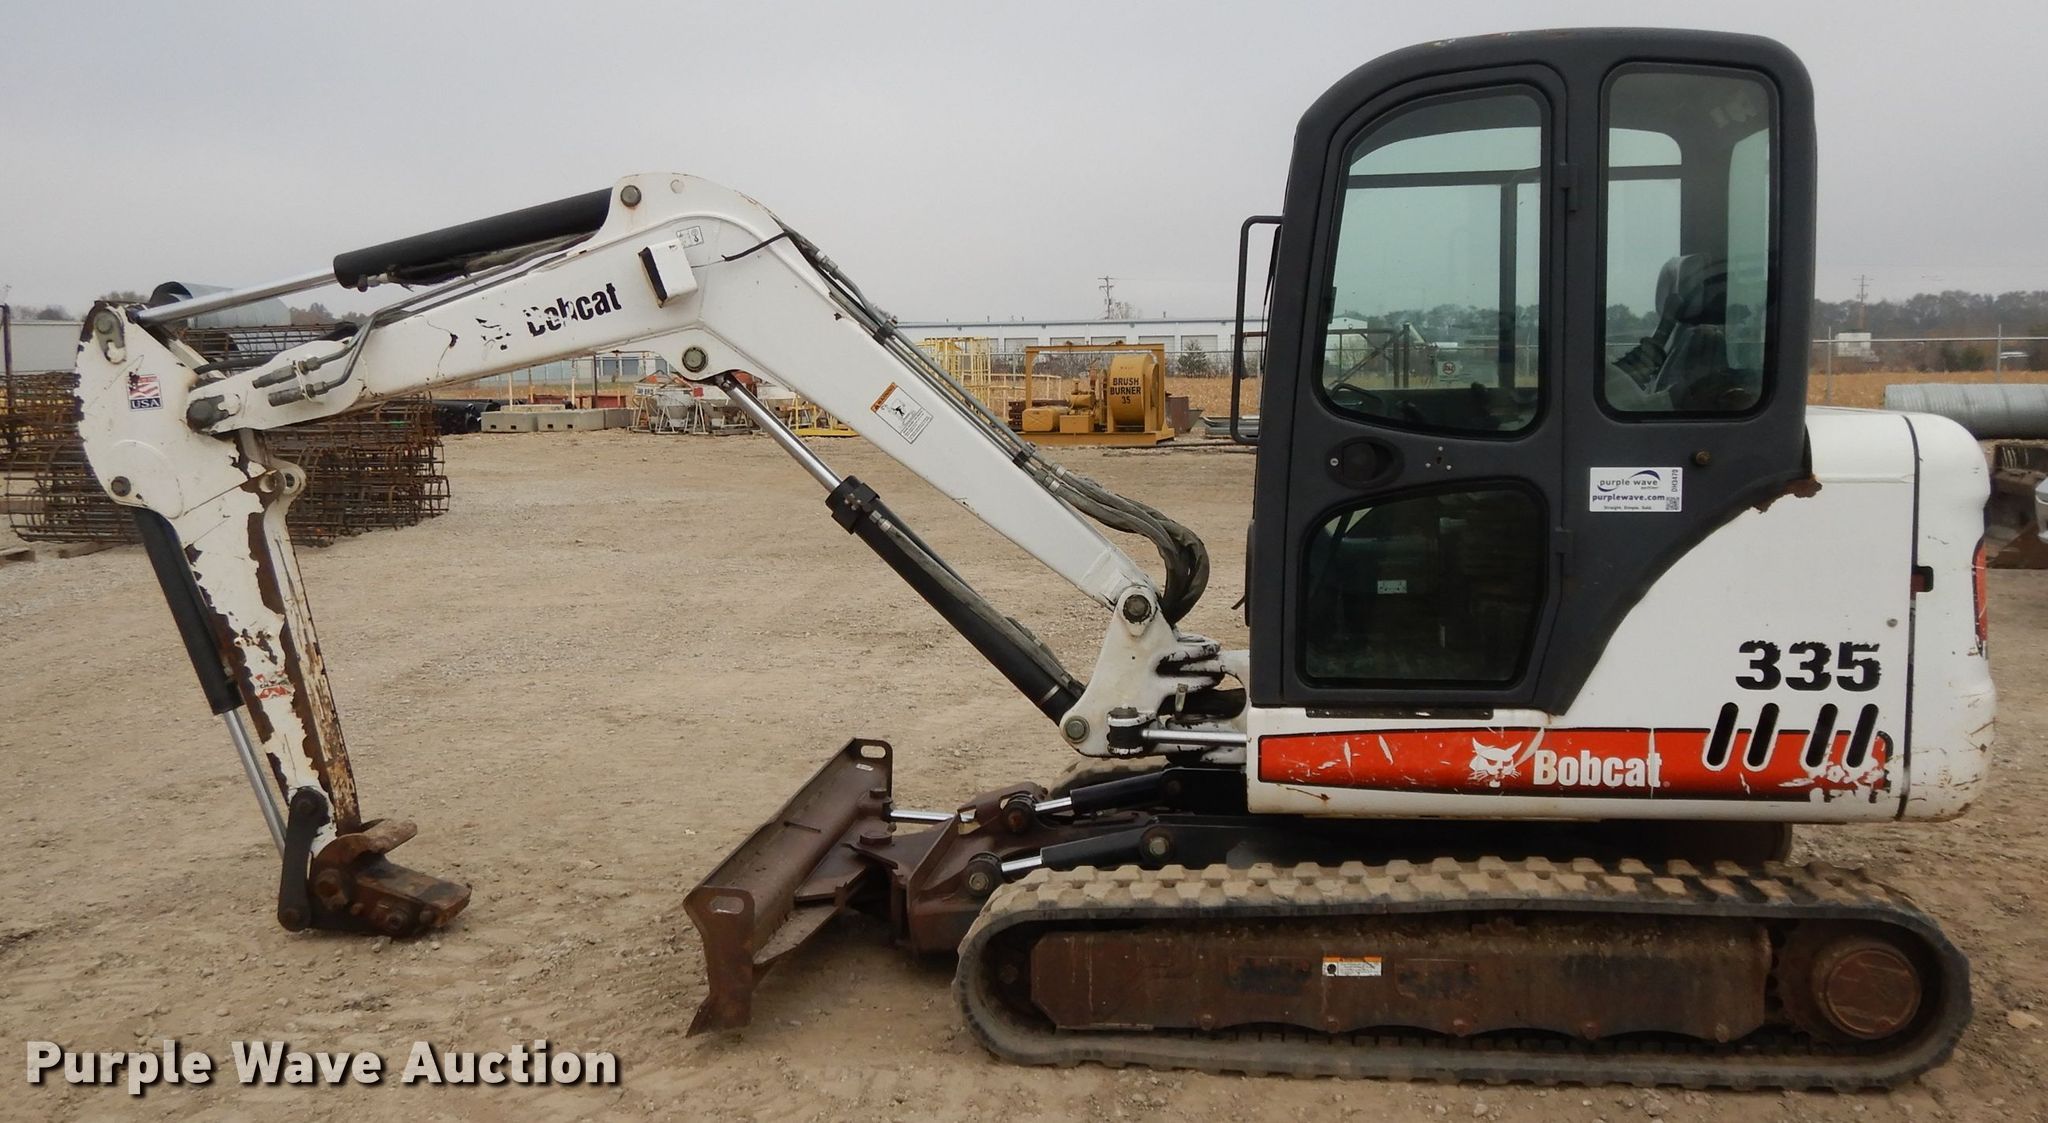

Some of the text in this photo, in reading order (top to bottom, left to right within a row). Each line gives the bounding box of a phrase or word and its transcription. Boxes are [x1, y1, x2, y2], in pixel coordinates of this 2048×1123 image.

[1112, 377, 1140, 386] BRUSH
[1110, 386, 1142, 395] BURNER
[131, 398, 160, 409] USA
[1121, 395, 1131, 405] 35
[1600, 478, 1631, 487] purple
[1592, 493, 1665, 503] purplewave.com
[1735, 640, 1882, 692] 335
[1533, 749, 1663, 788] Bobcat
